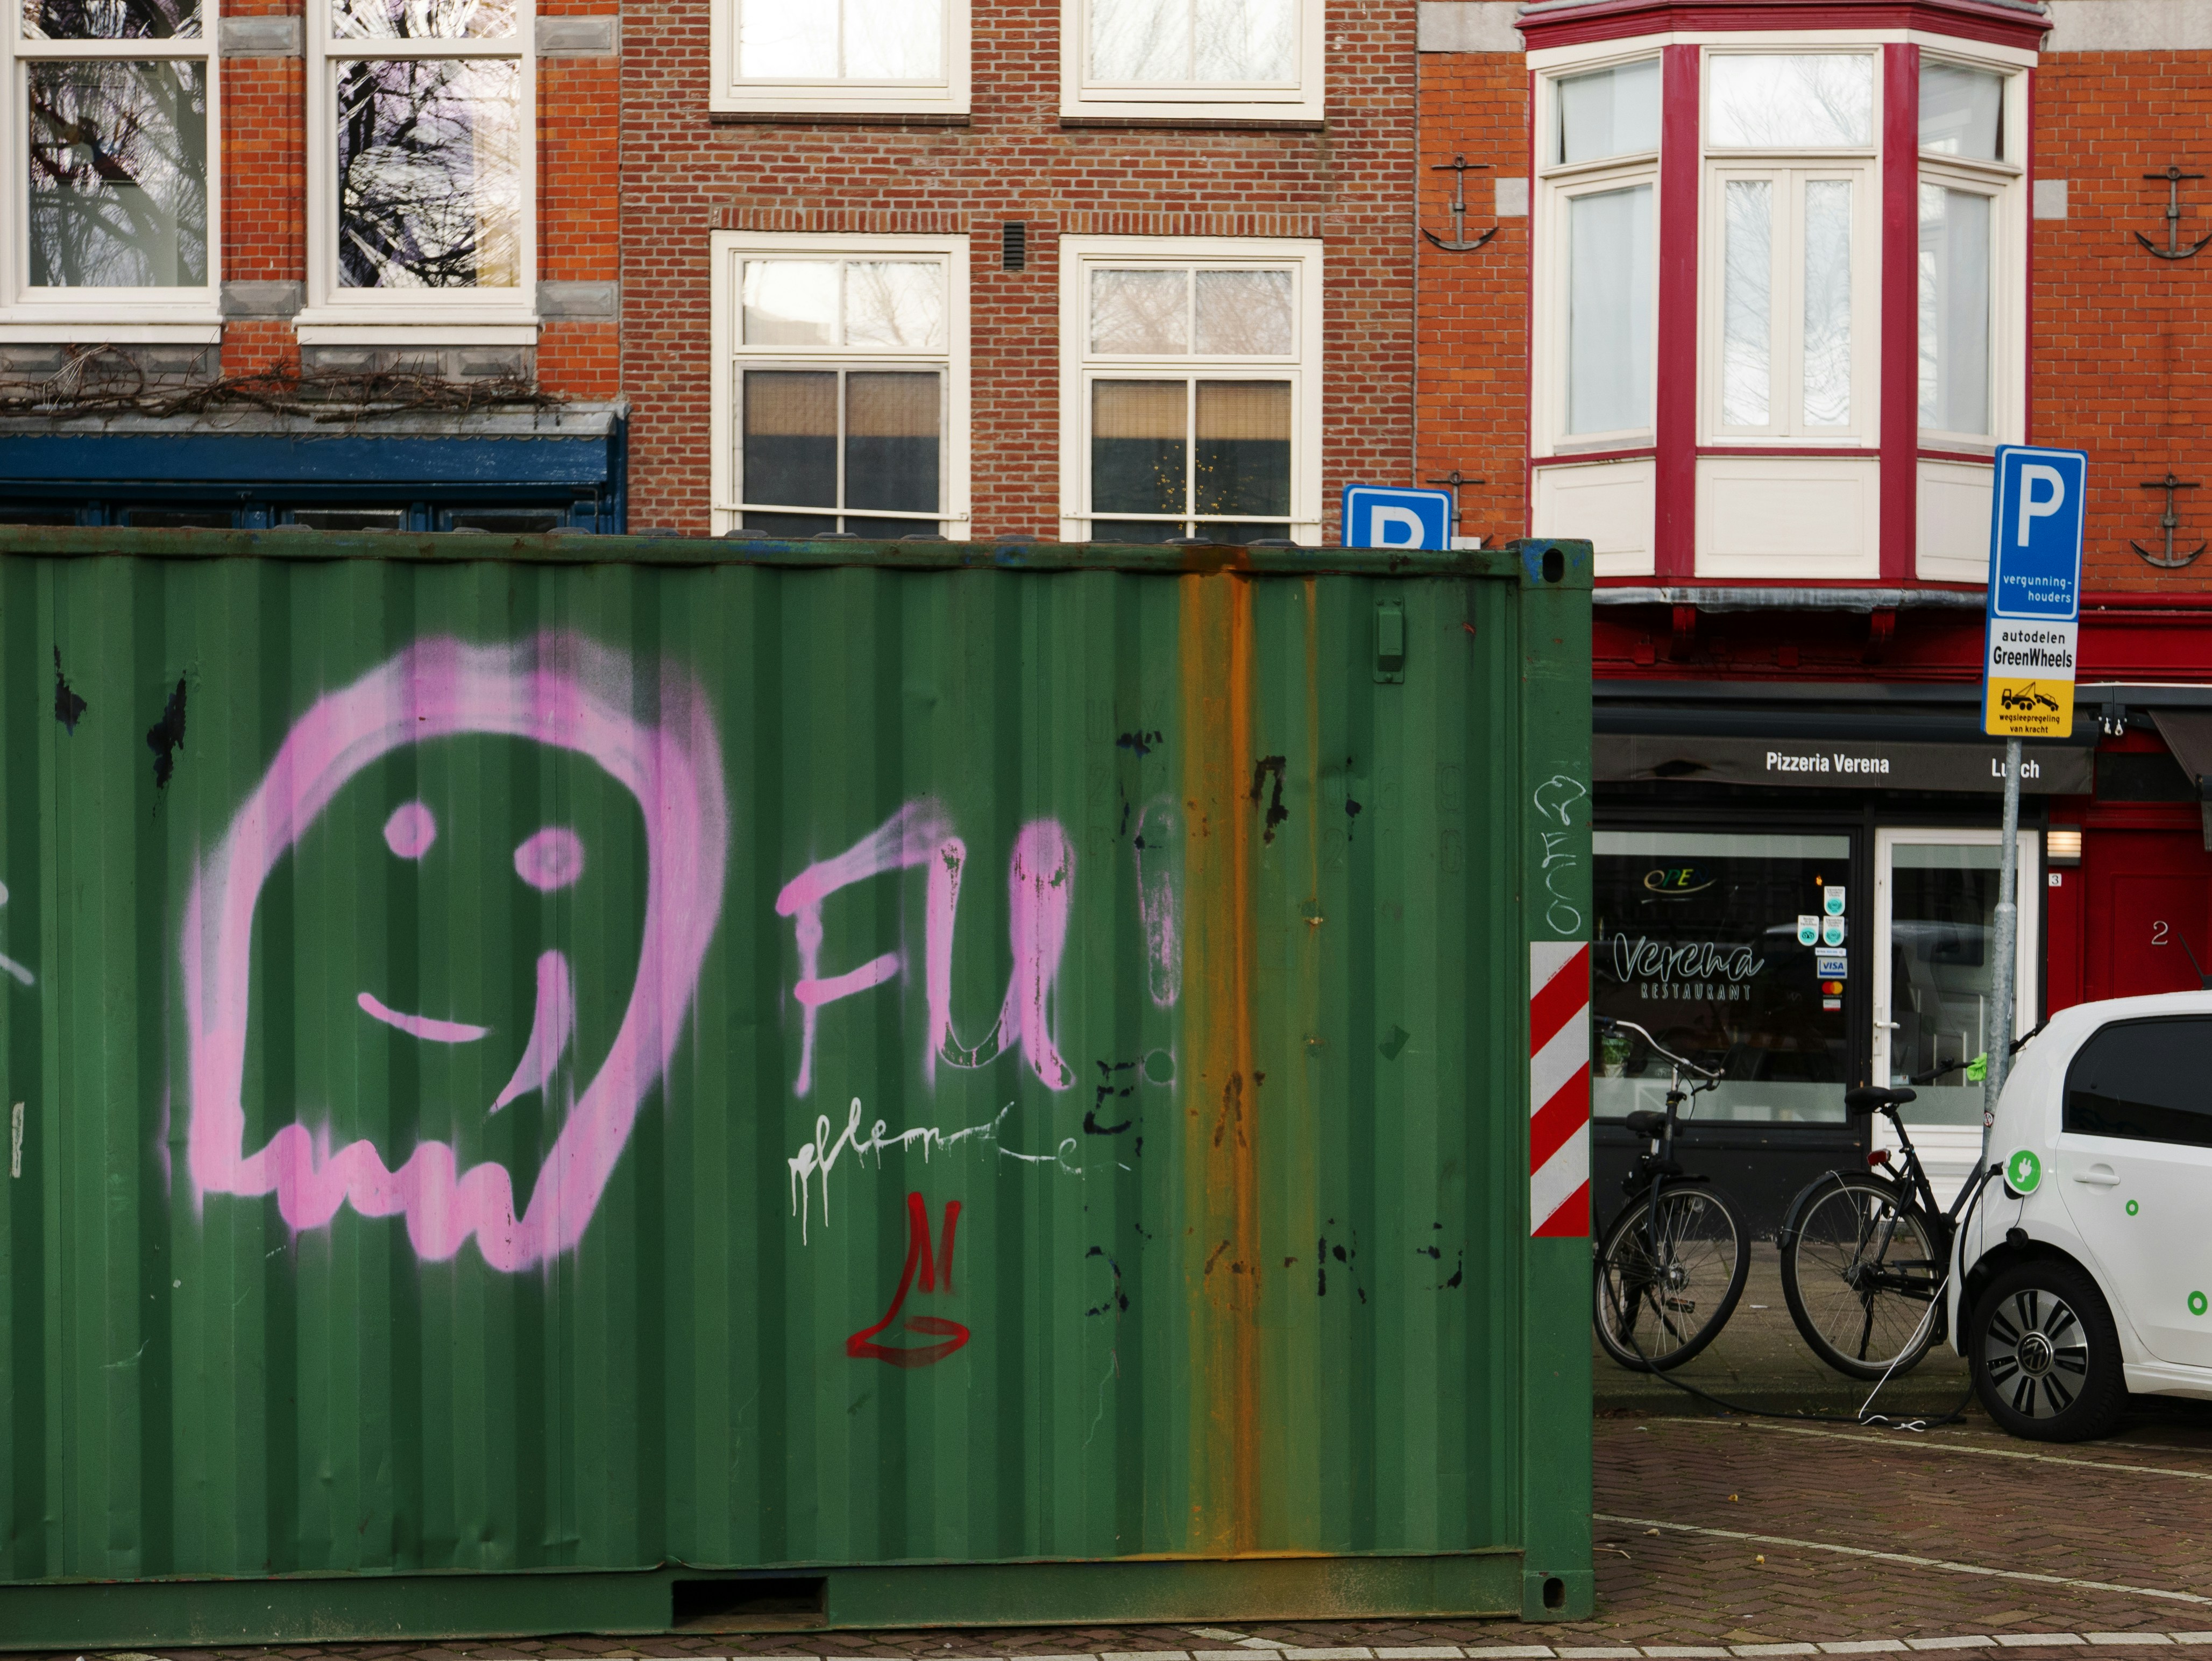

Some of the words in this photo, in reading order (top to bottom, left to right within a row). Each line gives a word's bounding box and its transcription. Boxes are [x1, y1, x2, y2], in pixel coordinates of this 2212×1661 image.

[2017, 463, 2065, 548] P
[2003, 574, 2072, 589] vergunning-
[2028, 590, 2071, 604] houders
[2002, 630, 2065, 644] autodelen
[1993, 645, 2073, 668] GreenWheels
[1999, 713, 2060, 725] wegsleepregeling
[2025, 725, 2048, 734] kracht
[1766, 751, 1829, 771] Pizzeria
[1833, 754, 1890, 773] Verena
[1991, 758, 2040, 778] Luch
[1644, 869, 1710, 889] OPEN
[2051, 875, 2059, 885] 3
[2151, 920, 2168, 946] 2
[1614, 932, 1764, 983] Verena
[1823, 962, 1844, 970] VISA
[1641, 982, 1750, 1001] RESTAURANT
